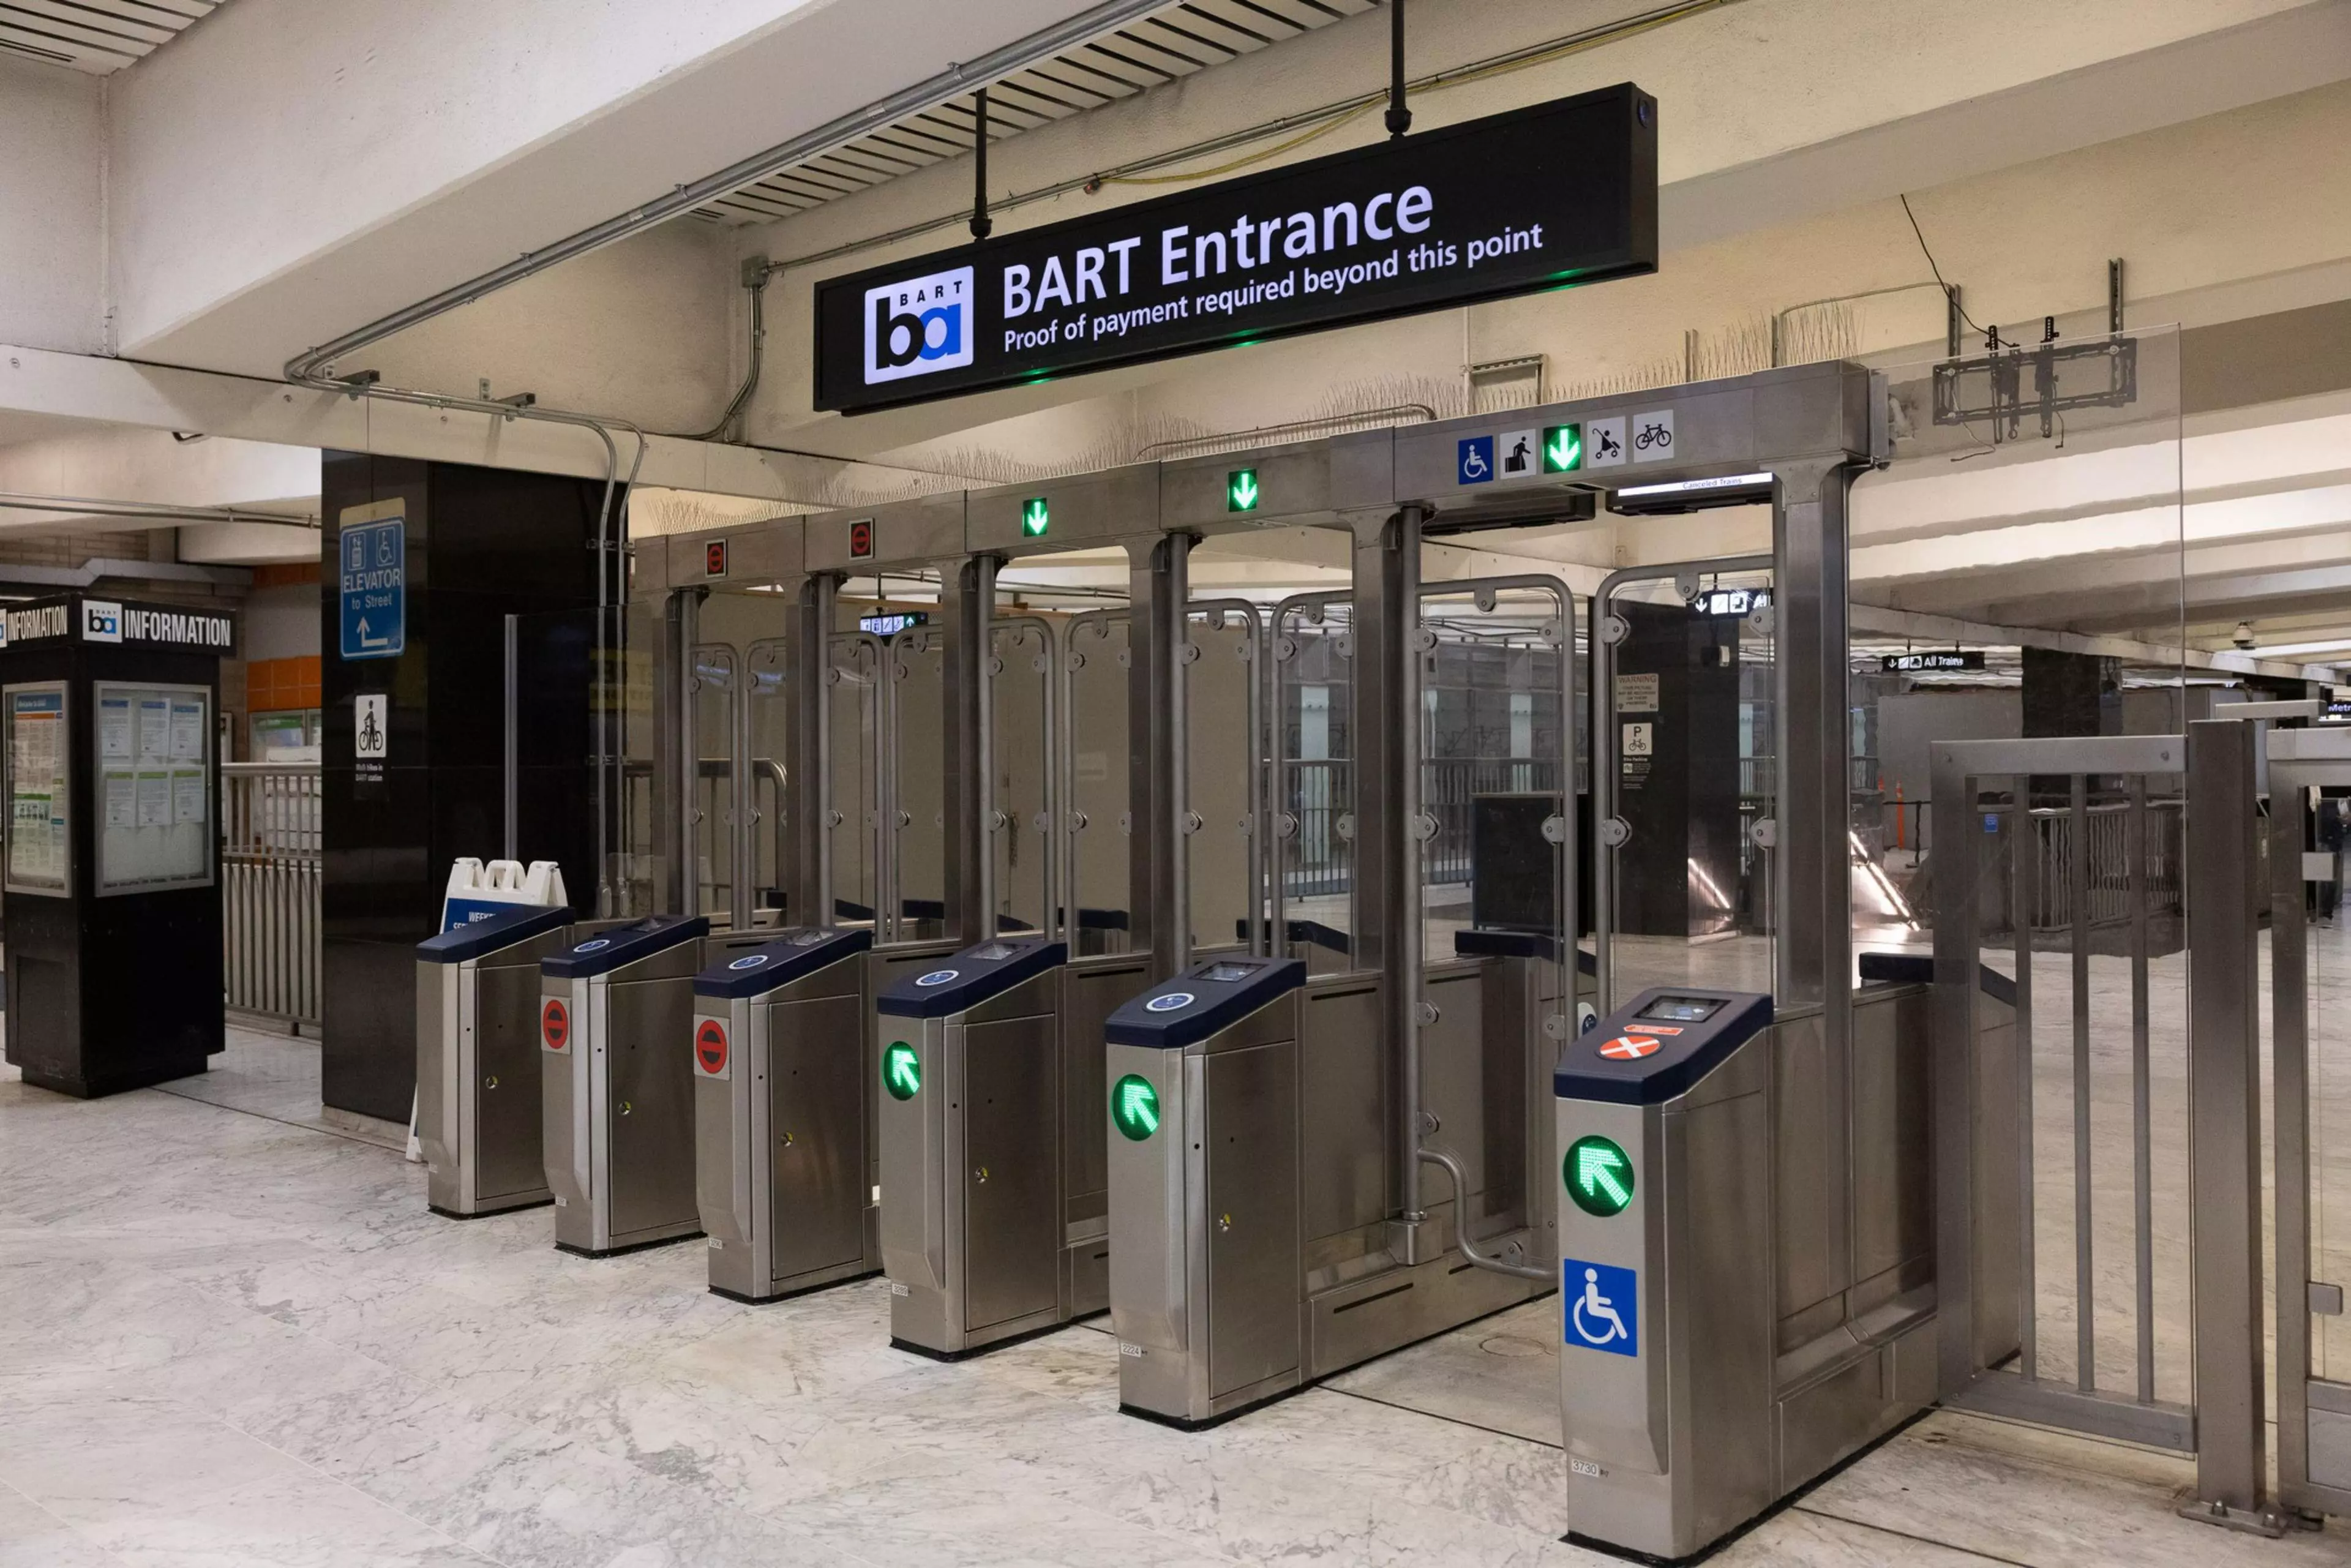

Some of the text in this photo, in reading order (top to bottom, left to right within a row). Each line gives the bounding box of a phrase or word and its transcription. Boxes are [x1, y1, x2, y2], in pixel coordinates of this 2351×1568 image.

[1004, 186, 1433, 319] BART Entrance
[900, 280, 962, 307] BART
[1005, 223, 1543, 352] Proof of payment required beyond this point
[876, 296, 961, 370] ba
[343, 568, 401, 593] ELEVATOR
[352, 592, 392, 610] to Street
[7, 605, 67, 642] INFORMATION
[125, 609, 231, 647] INFORMATION
[1924, 655, 1964, 667] All Trains
[1634, 726, 1641, 737] P
[469, 911, 496, 922] WEEK
[1573, 1460, 1597, 1474] 3730
